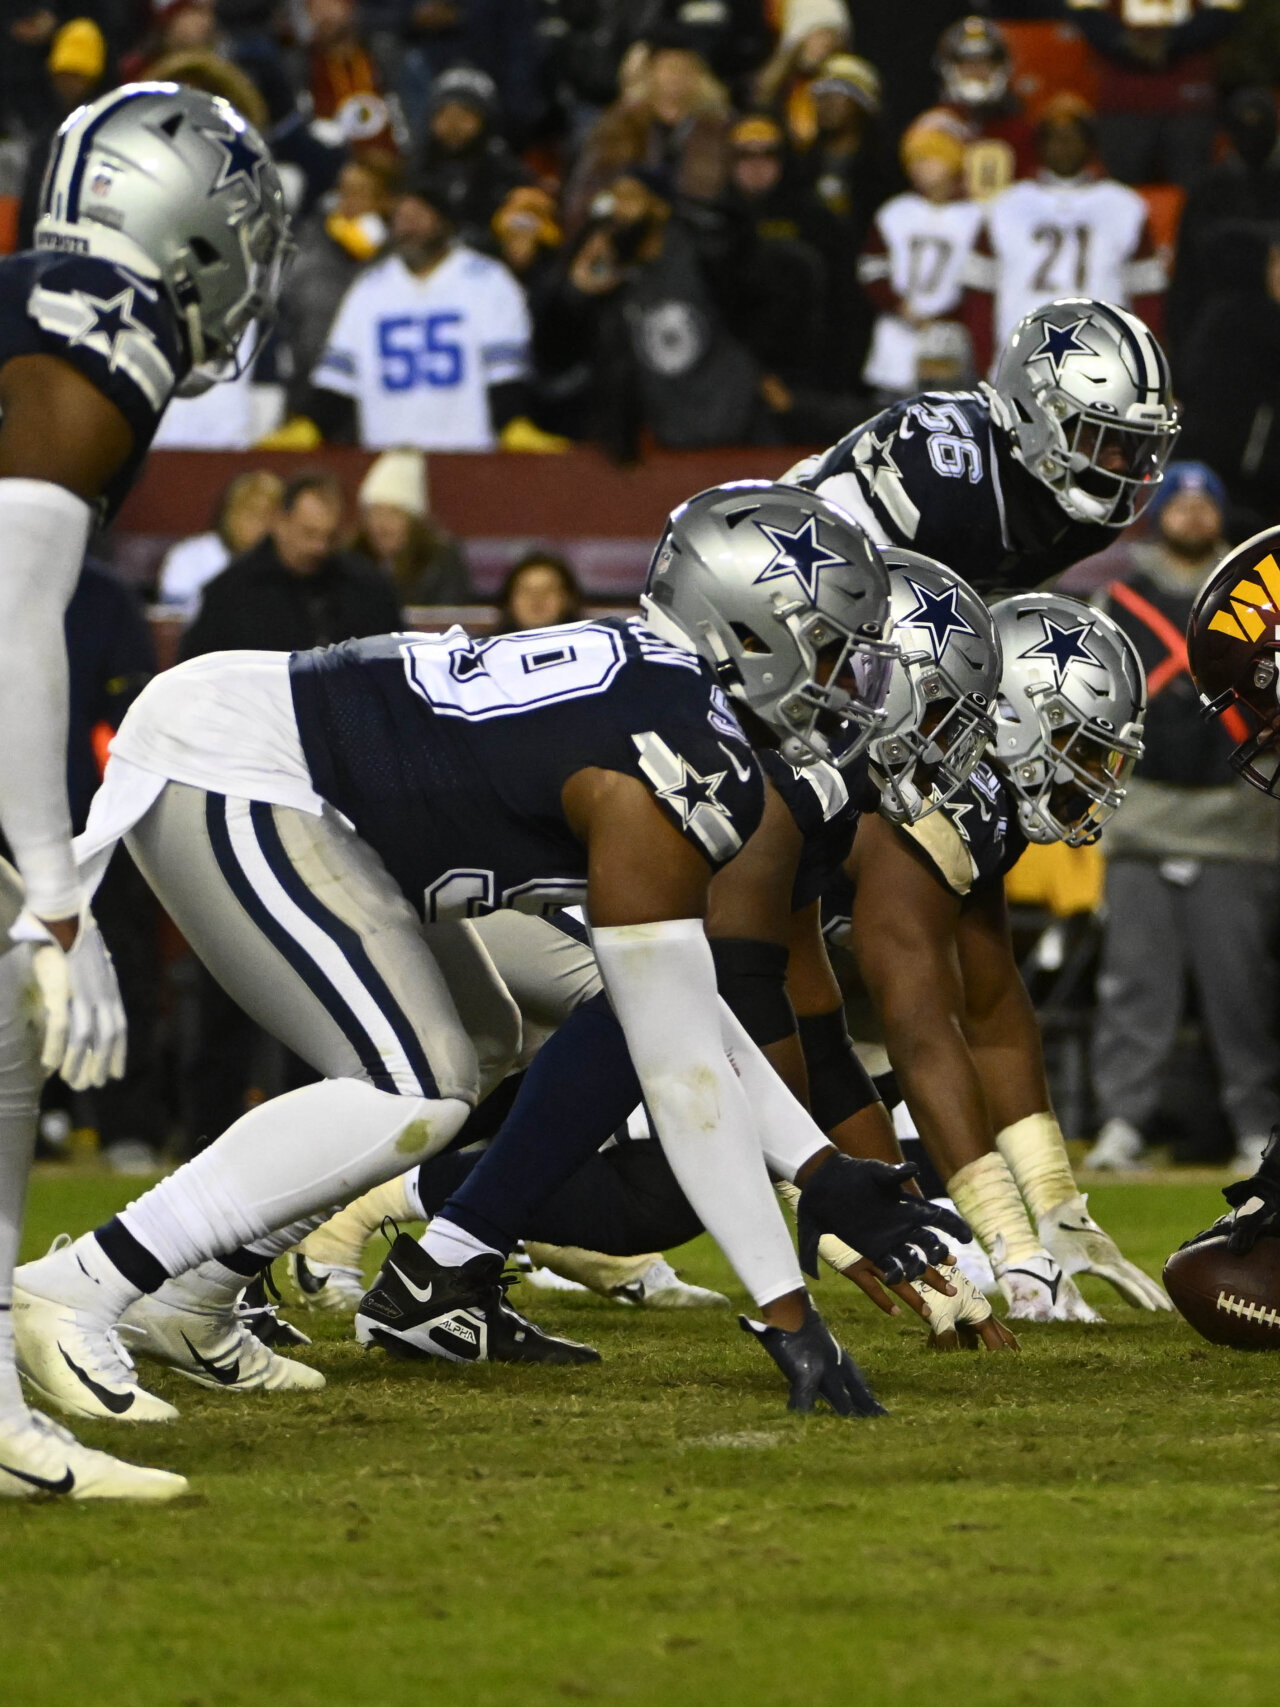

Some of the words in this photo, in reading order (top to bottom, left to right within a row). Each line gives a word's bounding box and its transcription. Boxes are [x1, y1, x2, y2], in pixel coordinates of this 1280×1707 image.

[1030, 222, 1092, 292] 21
[378, 311, 465, 391] 55
[906, 402, 984, 484] 56
[399, 618, 628, 722] 9
[439, 1320, 476, 1342] ALPHA
